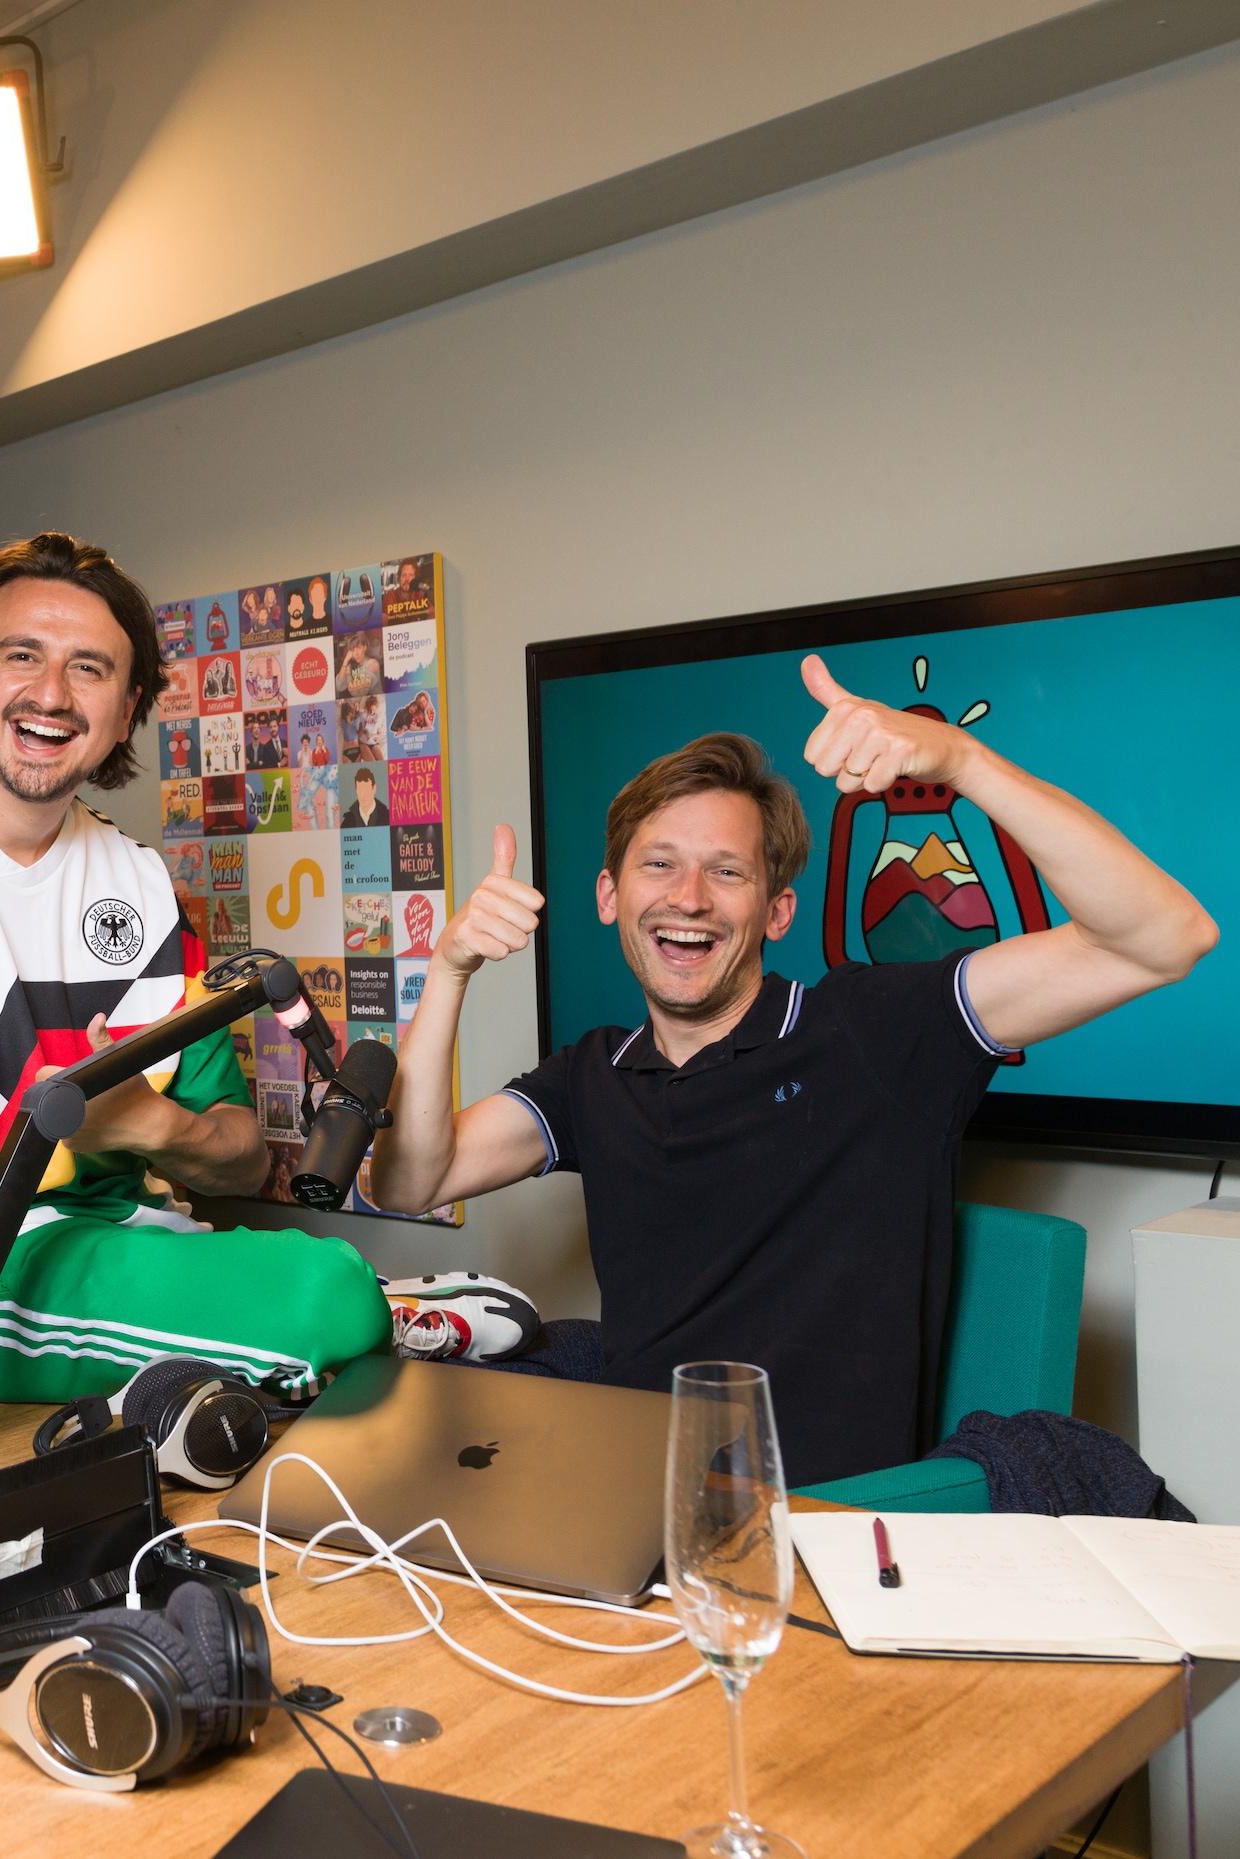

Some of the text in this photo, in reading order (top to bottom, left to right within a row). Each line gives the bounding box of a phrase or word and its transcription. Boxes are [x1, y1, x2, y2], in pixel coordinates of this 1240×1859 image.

[387, 598, 428, 614] PEPTALK
[387, 632, 409, 642] Jong
[388, 637, 432, 651] Beleggen
[396, 653, 414, 661] podcast
[301, 660, 319, 670] ECHT
[294, 668, 326, 680] GEBEURD
[244, 709, 287, 726] POM
[300, 709, 323, 720] GOED
[166, 720, 192, 731] MET NERDS
[298, 717, 326, 728] NIEUWS
[389, 758, 436, 775] DE EEUW
[170, 768, 192, 779] OM TAFEL
[390, 773, 433, 792] VAN DE
[391, 788, 440, 821] AMATEUR
[164, 827, 203, 837] de Millennial
[211, 840, 242, 856] MAN
[344, 848, 360, 856] met
[400, 842, 434, 857] GAITE &
[210, 854, 244, 870] man
[344, 862, 354, 870] de
[400, 858, 434, 872] MELODY
[213, 868, 243, 882] MAN
[345, 874, 389, 884] microfoon
[346, 898, 390, 912] SKETCHES
[89, 902, 137, 922] DEUTSCHER
[362, 912, 379, 922] gelul
[232, 924, 248, 933] DE
[411, 918, 430, 936] der
[211, 934, 248, 943] LEEUW
[413, 928, 430, 948] ing
[88, 934, 141, 962] FUSSBALL-BUND
[350, 970, 378, 980] Insights
[351, 980, 386, 990] responsible
[351, 990, 378, 999] business
[310, 995, 341, 1008] PSAUS
[352, 1005, 387, 1015] Deloitte.
[272, 1083, 299, 1092] VOEDSEL
[220, 1414, 239, 1452] SHURE
[82, 1693, 98, 1750] SHURE
